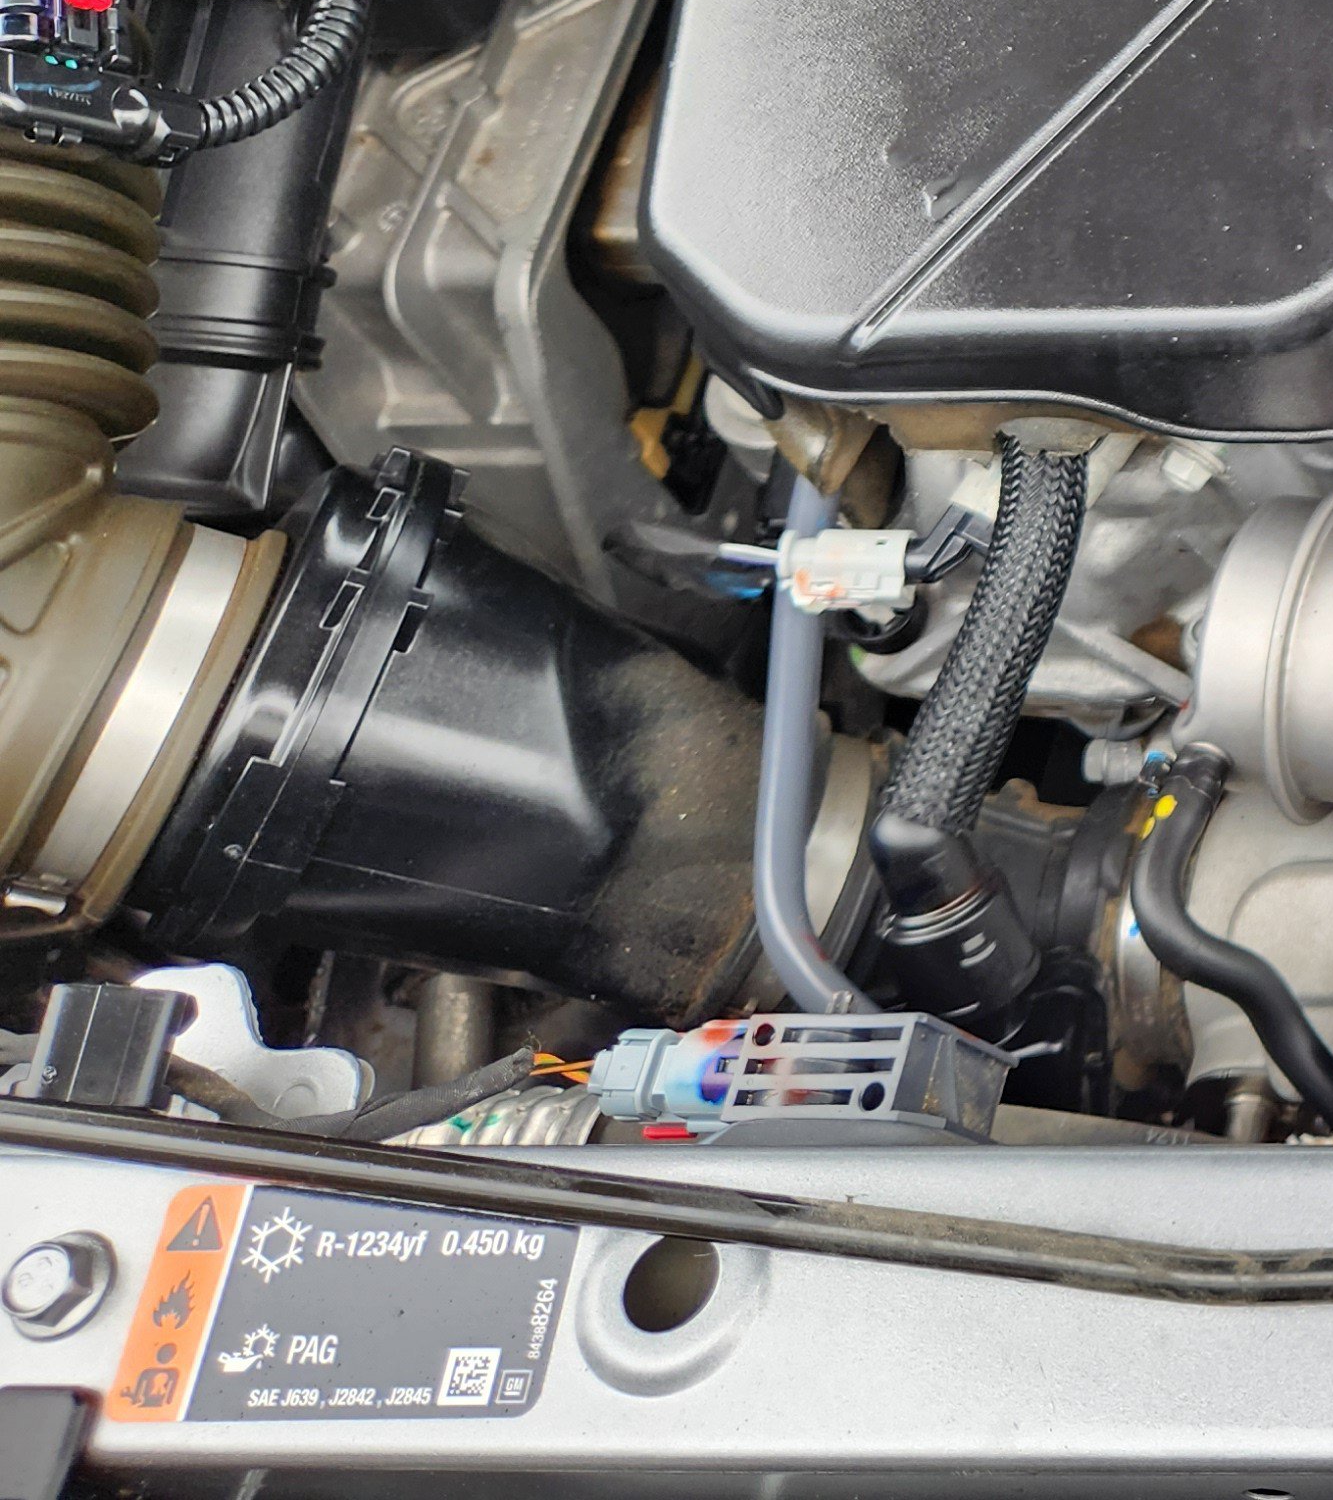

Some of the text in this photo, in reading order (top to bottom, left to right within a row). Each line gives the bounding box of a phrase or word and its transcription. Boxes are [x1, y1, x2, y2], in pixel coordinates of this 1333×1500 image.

[315, 1229, 546, 1262] R-1234yf 0.450 kg
[286, 1334, 339, 1366] PAG
[247, 1388, 279, 1407] SAE
[385, 1386, 433, 1406] J2845
